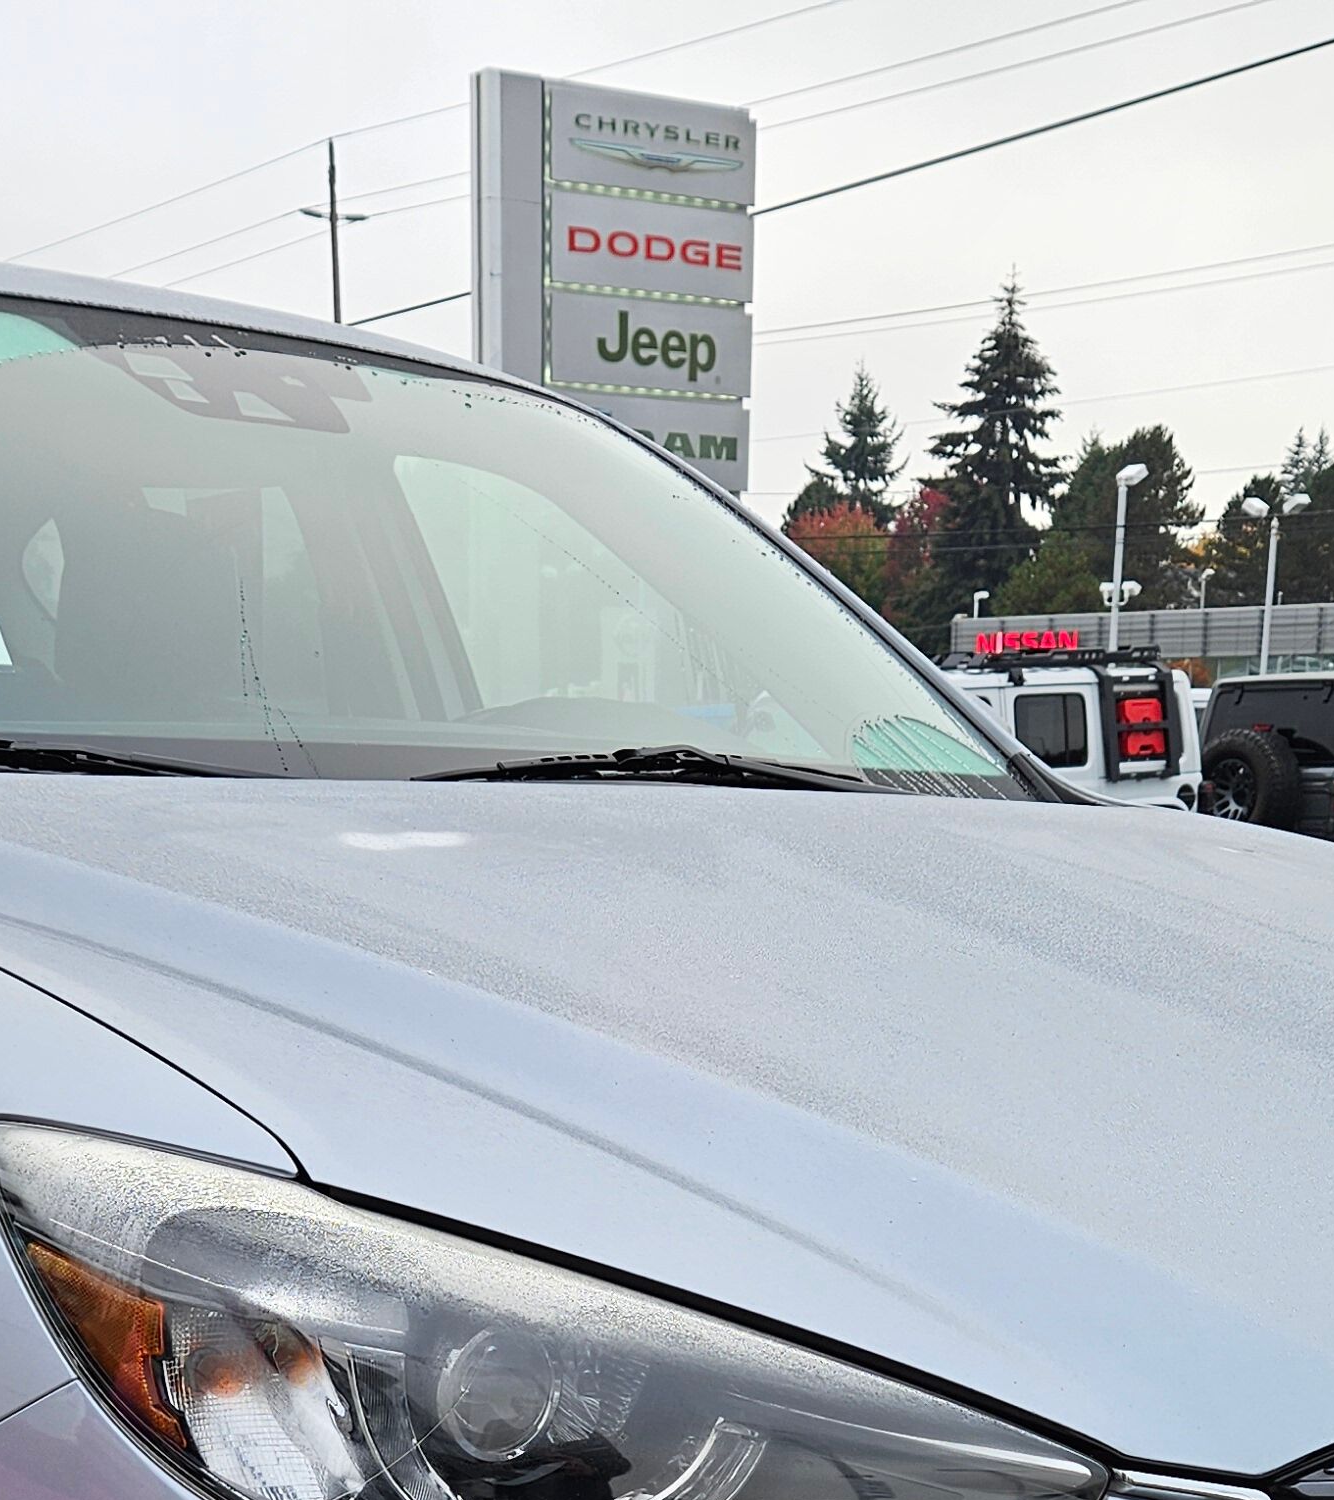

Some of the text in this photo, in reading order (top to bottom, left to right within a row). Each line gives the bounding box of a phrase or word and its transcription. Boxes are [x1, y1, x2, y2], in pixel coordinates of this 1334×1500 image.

[574, 113, 741, 151] CHRYSLER
[567, 226, 743, 271] DODGE
[596, 310, 717, 382] Jeep
[634, 428, 738, 462] AM
[975, 627, 1079, 655] NISSAN
